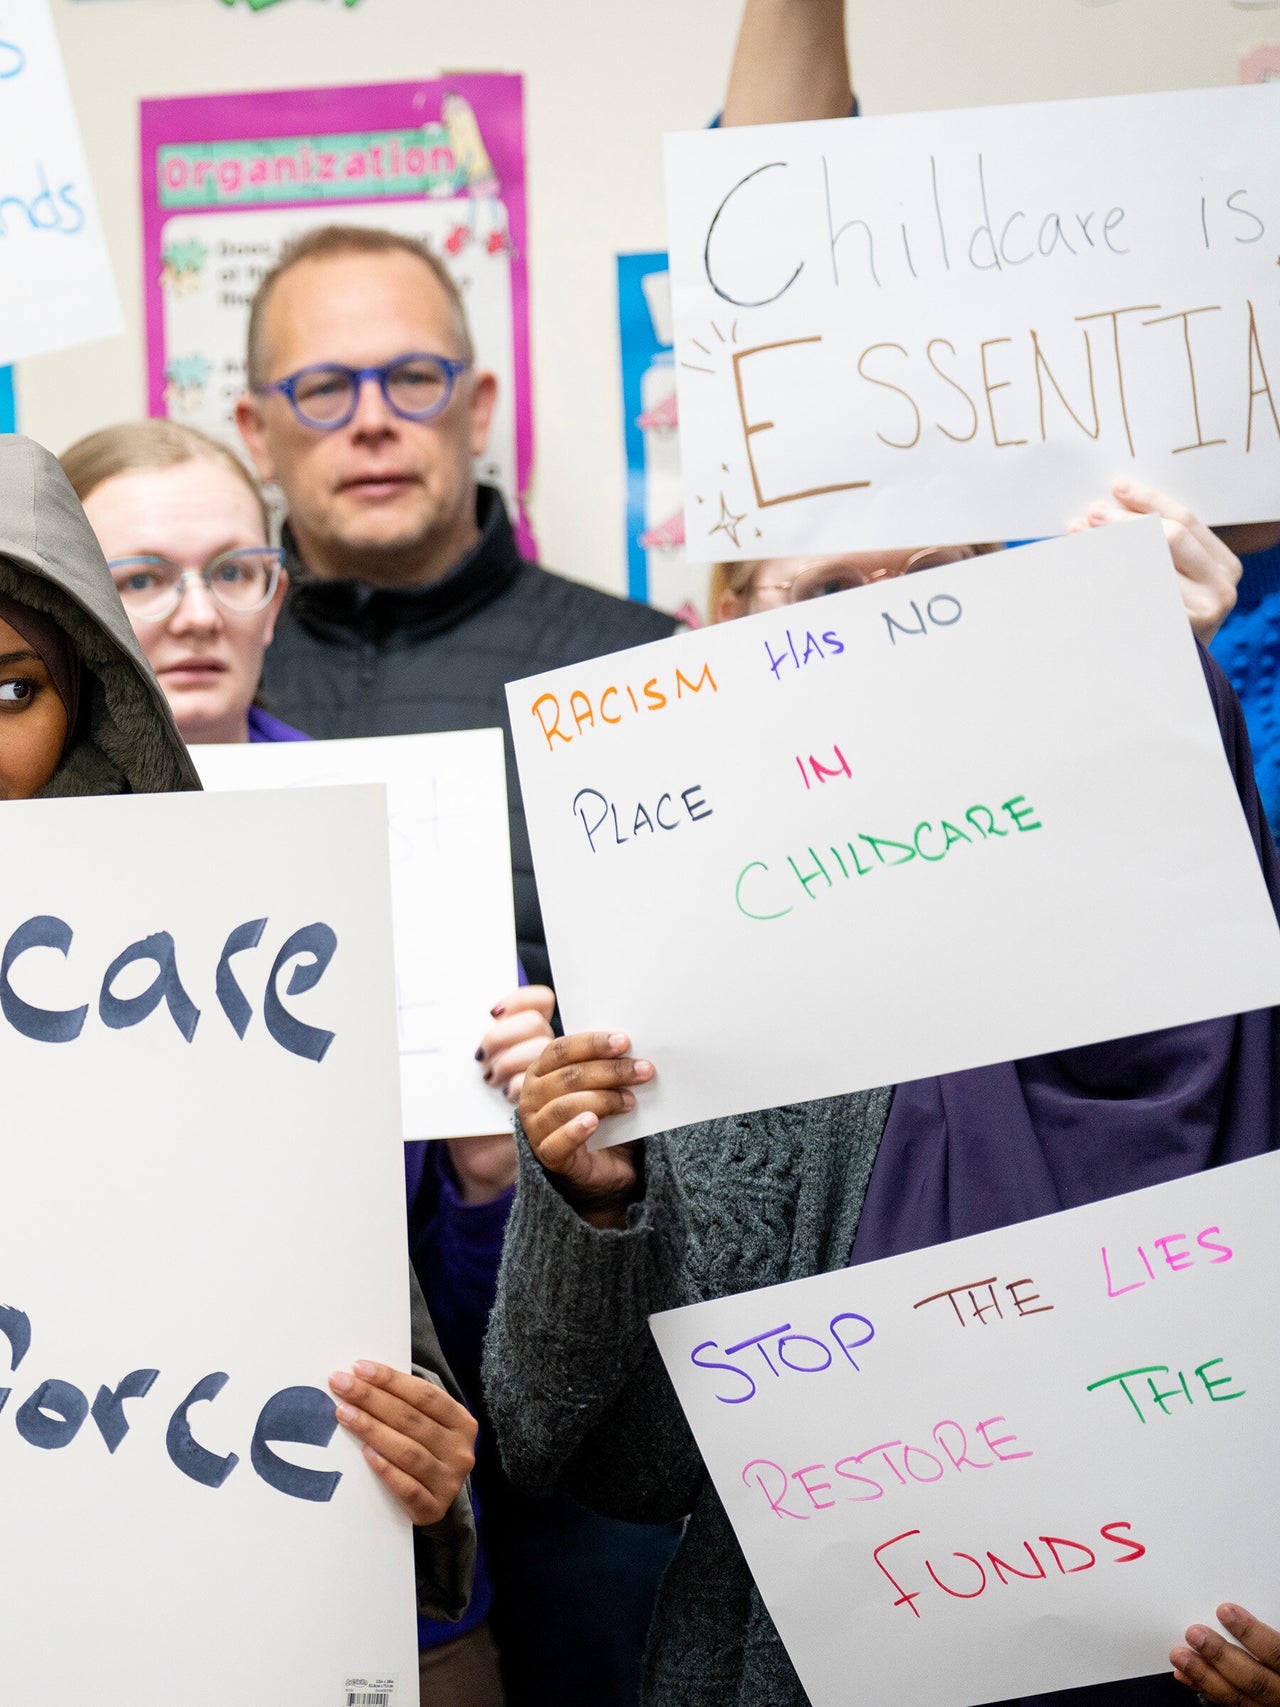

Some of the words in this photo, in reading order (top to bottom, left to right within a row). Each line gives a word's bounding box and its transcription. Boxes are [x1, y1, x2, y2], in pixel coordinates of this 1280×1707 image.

[164, 141, 458, 192] Organization
[704, 153, 1131, 307] Childcare
[1198, 176, 1266, 250] is
[731, 298, 1280, 509] ESSENTIA
[530, 662, 719, 753] RACISM
[763, 629, 846, 682] HAS
[880, 592, 964, 647] NO
[572, 784, 715, 854] PLACE
[794, 744, 854, 791] IN
[735, 793, 1044, 921] CHILDCARE
[690, 1311, 876, 1404] STOP
[912, 1276, 1056, 1328] THE
[1099, 1225, 1235, 1299] LIES
[741, 1415, 1035, 1521] RESTORE
[1086, 1356, 1247, 1425] THE
[872, 1520, 1148, 1619] FUNDS
